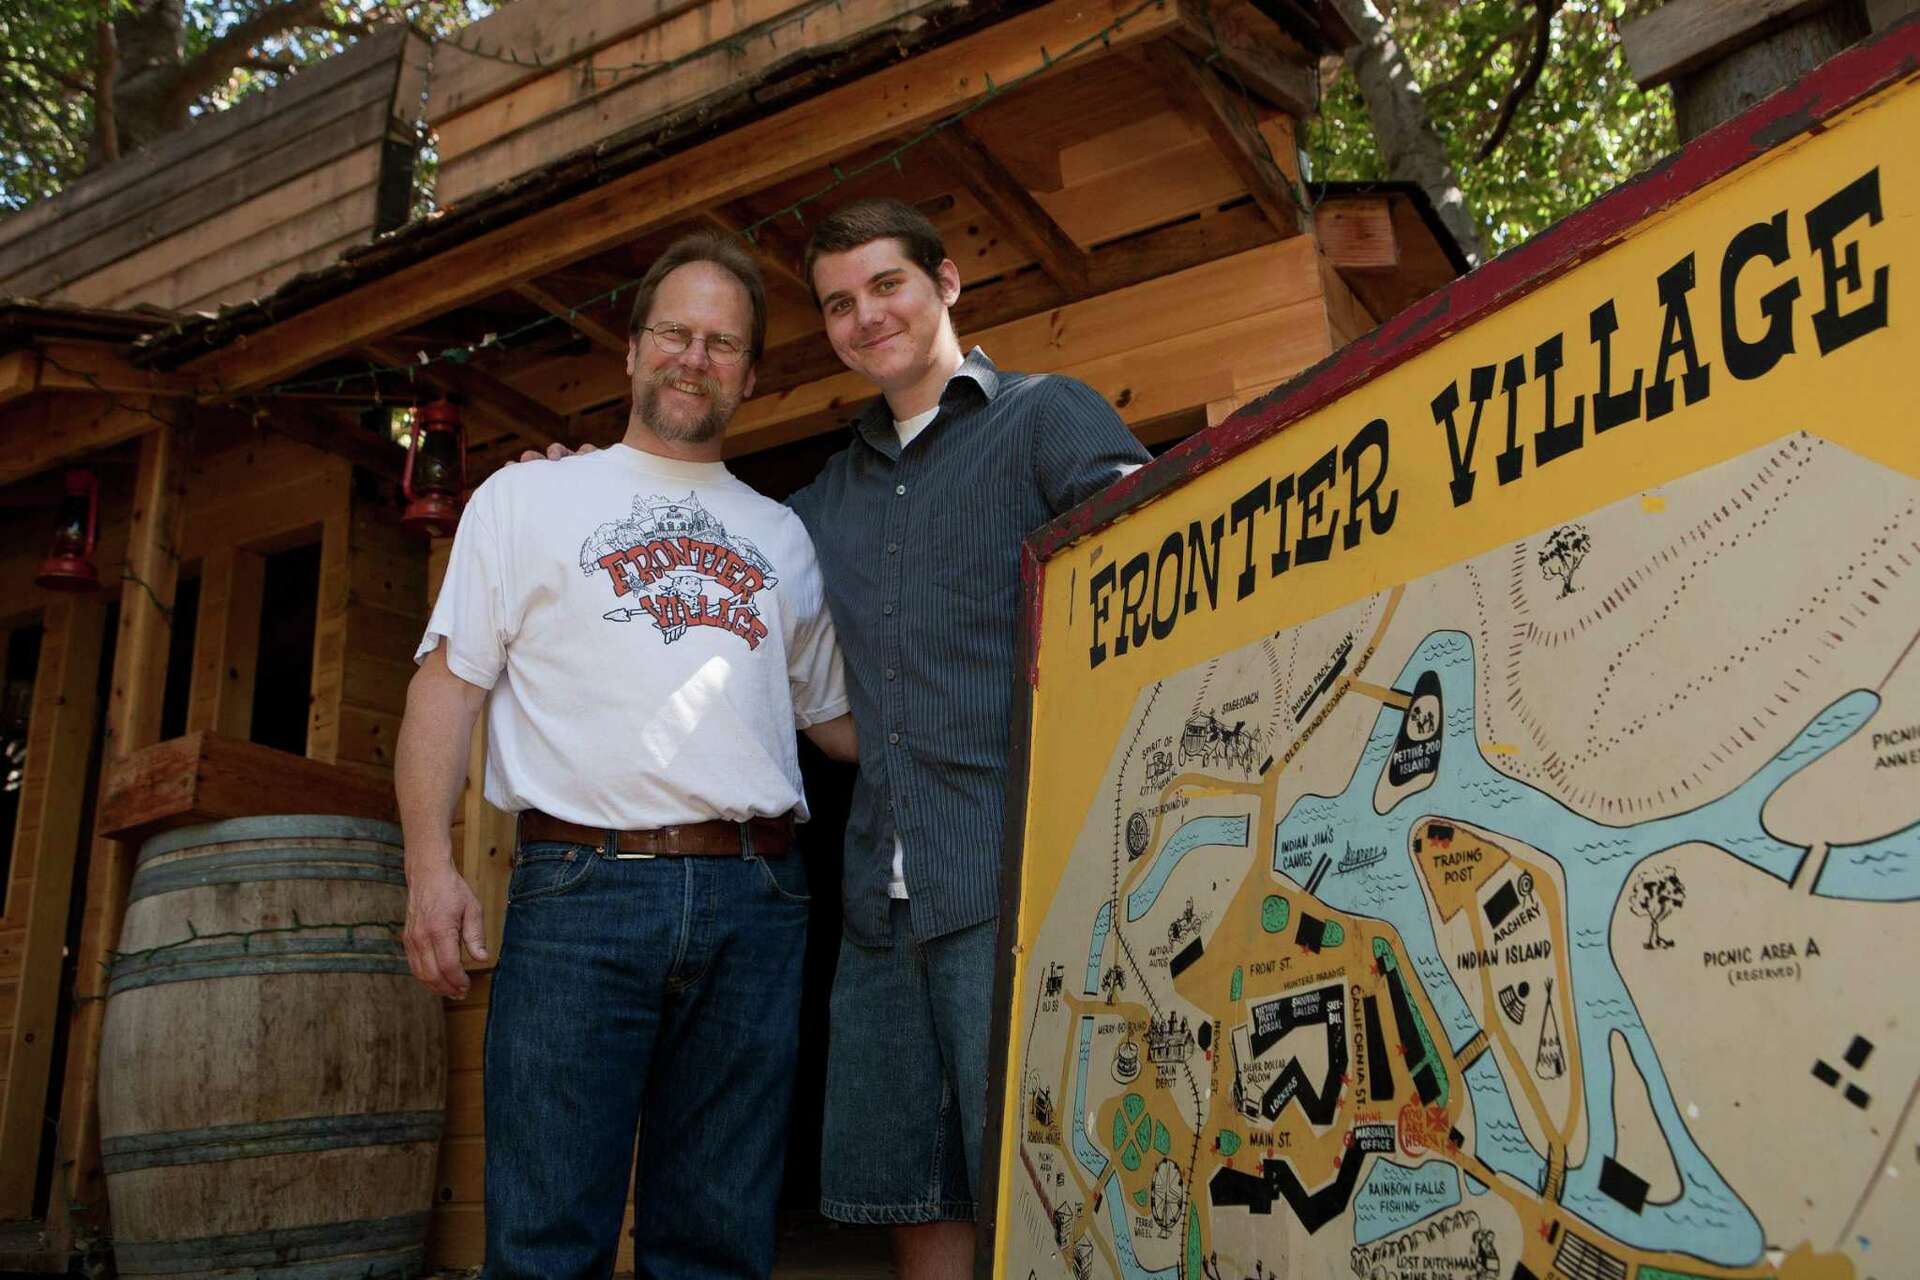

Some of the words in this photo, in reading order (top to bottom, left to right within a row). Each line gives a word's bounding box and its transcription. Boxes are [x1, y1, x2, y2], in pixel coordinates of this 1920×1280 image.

[1089, 418, 1399, 670] FRONTIER
[1430, 165, 1890, 508] VILLAGE
[597, 536, 764, 604] FRONTIER
[639, 595, 768, 651] VILLAGE
[1312, 662, 1331, 684] PACK
[1330, 631, 1354, 661] TRAIN
[1221, 690, 1260, 715] STAGECOACH
[1284, 741, 1301, 763] OLD
[1302, 680, 1351, 742] STAGECOACH
[1354, 646, 1375, 676] ROAD
[1872, 725, 1920, 750] PICNI
[1393, 744, 1424, 765] PETTING
[1425, 740, 1440, 754] ZOO
[1400, 757, 1430, 774] ISLAND
[1281, 834, 1309, 853] INDIAN
[1311, 824, 1334, 847] JIM'S
[1282, 850, 1312, 870] CANOES
[1433, 847, 1483, 868] TRADING
[1444, 866, 1474, 884] POST
[1492, 903, 1541, 946] ARCHERY
[1457, 947, 1499, 969] INDIAN
[1505, 940, 1552, 964] ISLAND
[1703, 946, 1752, 967] PICNIC
[1761, 941, 1797, 961] AREA
[1805, 937, 1821, 958] A
[1250, 960, 1276, 977] FRONT
[1727, 962, 1802, 986] (RESERVED)
[1350, 984, 1366, 1085] CALIFORNIA
[1156, 1065, 1177, 1076] TRAIN
[1156, 1078, 1177, 1088] DEPOT
[1249, 1131, 1274, 1147] MAIN
[1360, 1139, 1392, 1150] OFFICE
[1368, 1182, 1411, 1197] RAINBOW
[1415, 1181, 1447, 1195] FALLS
[1380, 1199, 1420, 1213] FISHING
[1396, 1256, 1419, 1269] LOST
[1423, 1256, 1478, 1270] DUTCHMAN
